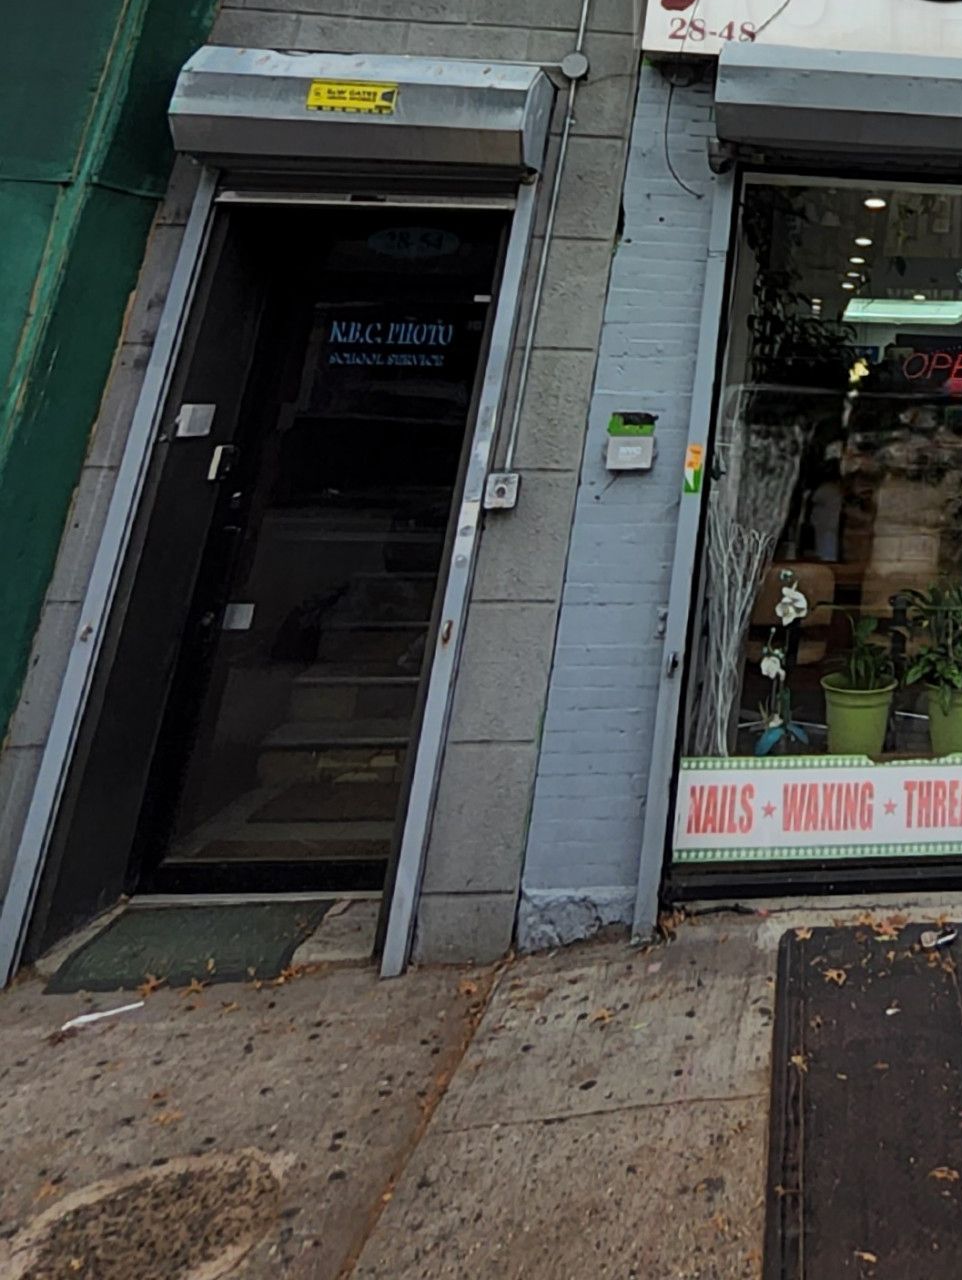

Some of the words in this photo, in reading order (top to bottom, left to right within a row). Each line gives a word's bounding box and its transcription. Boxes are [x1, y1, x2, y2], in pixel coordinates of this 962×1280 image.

[668, 17, 757, 42] 28-48
[385, 322, 454, 346] PHOTO
[686, 783, 755, 835] NAILS
[781, 781, 875, 833] WAXING
